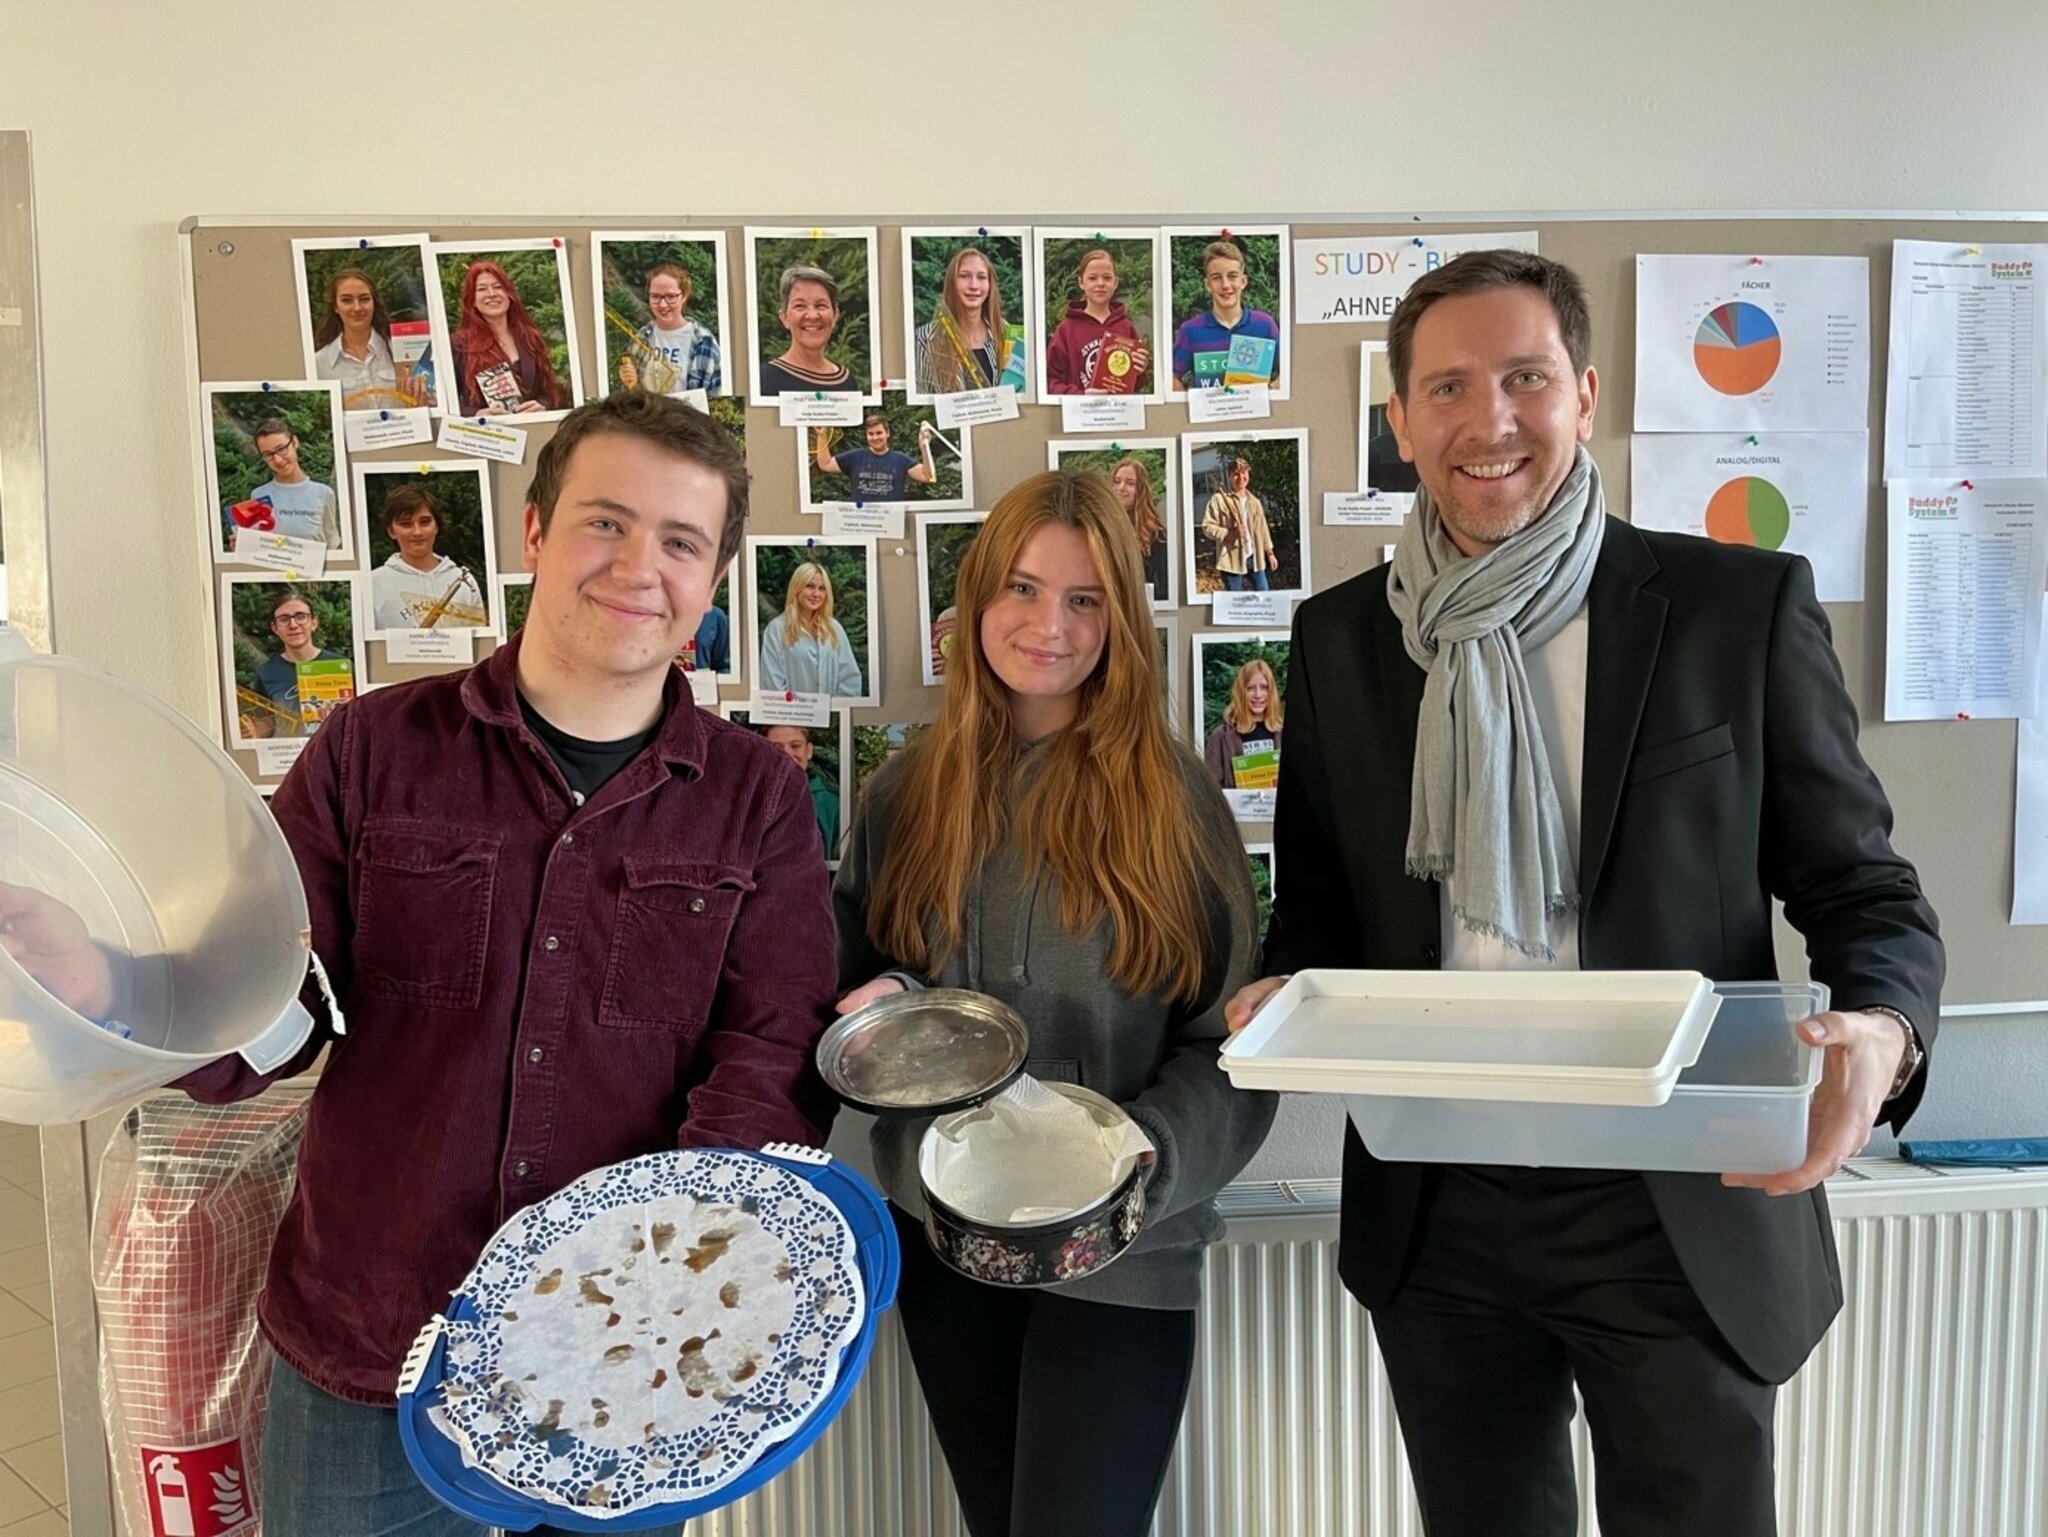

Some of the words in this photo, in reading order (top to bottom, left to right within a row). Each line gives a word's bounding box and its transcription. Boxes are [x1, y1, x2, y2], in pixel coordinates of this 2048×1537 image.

[1314, 251, 1400, 276] STUDY
[1741, 281, 1771, 290] FÄCHER
[1716, 457, 1781, 465] ANALOG/DIGITAL
[1908, 497, 1945, 508] Buddy
[1908, 507, 1947, 517] System
